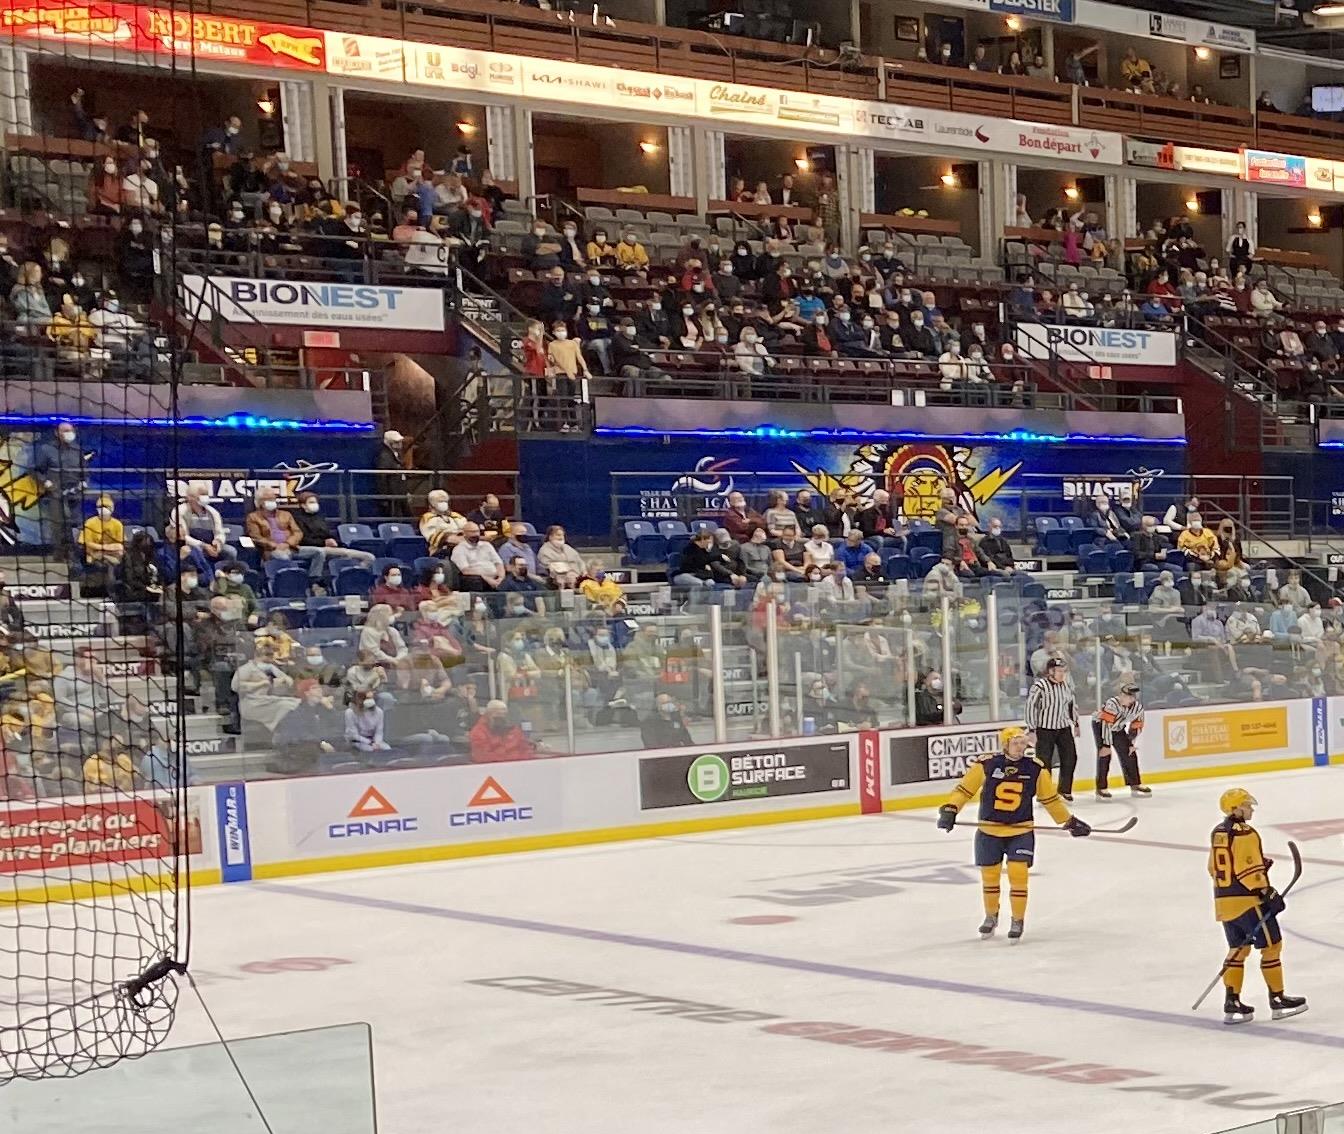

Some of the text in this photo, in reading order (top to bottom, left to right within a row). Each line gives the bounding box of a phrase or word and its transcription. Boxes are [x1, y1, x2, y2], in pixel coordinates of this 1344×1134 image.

[150, 11, 256, 45] ROBERT
[231, 280, 402, 311] BIONEST
[1047, 327, 1151, 350] BIONEST
[731, 753, 786, 769] BÉTON
[864, 738, 876, 797] CCM
[731, 766, 806, 786] SURFACE
[993, 781, 1025, 812] S
[104, 815, 136, 831] du
[329, 817, 418, 838] CANAC
[449, 806, 533, 827] CANAC
[467, 974, 780, 1026] CENTRE
[759, 1020, 1158, 1086] GERVAIS
